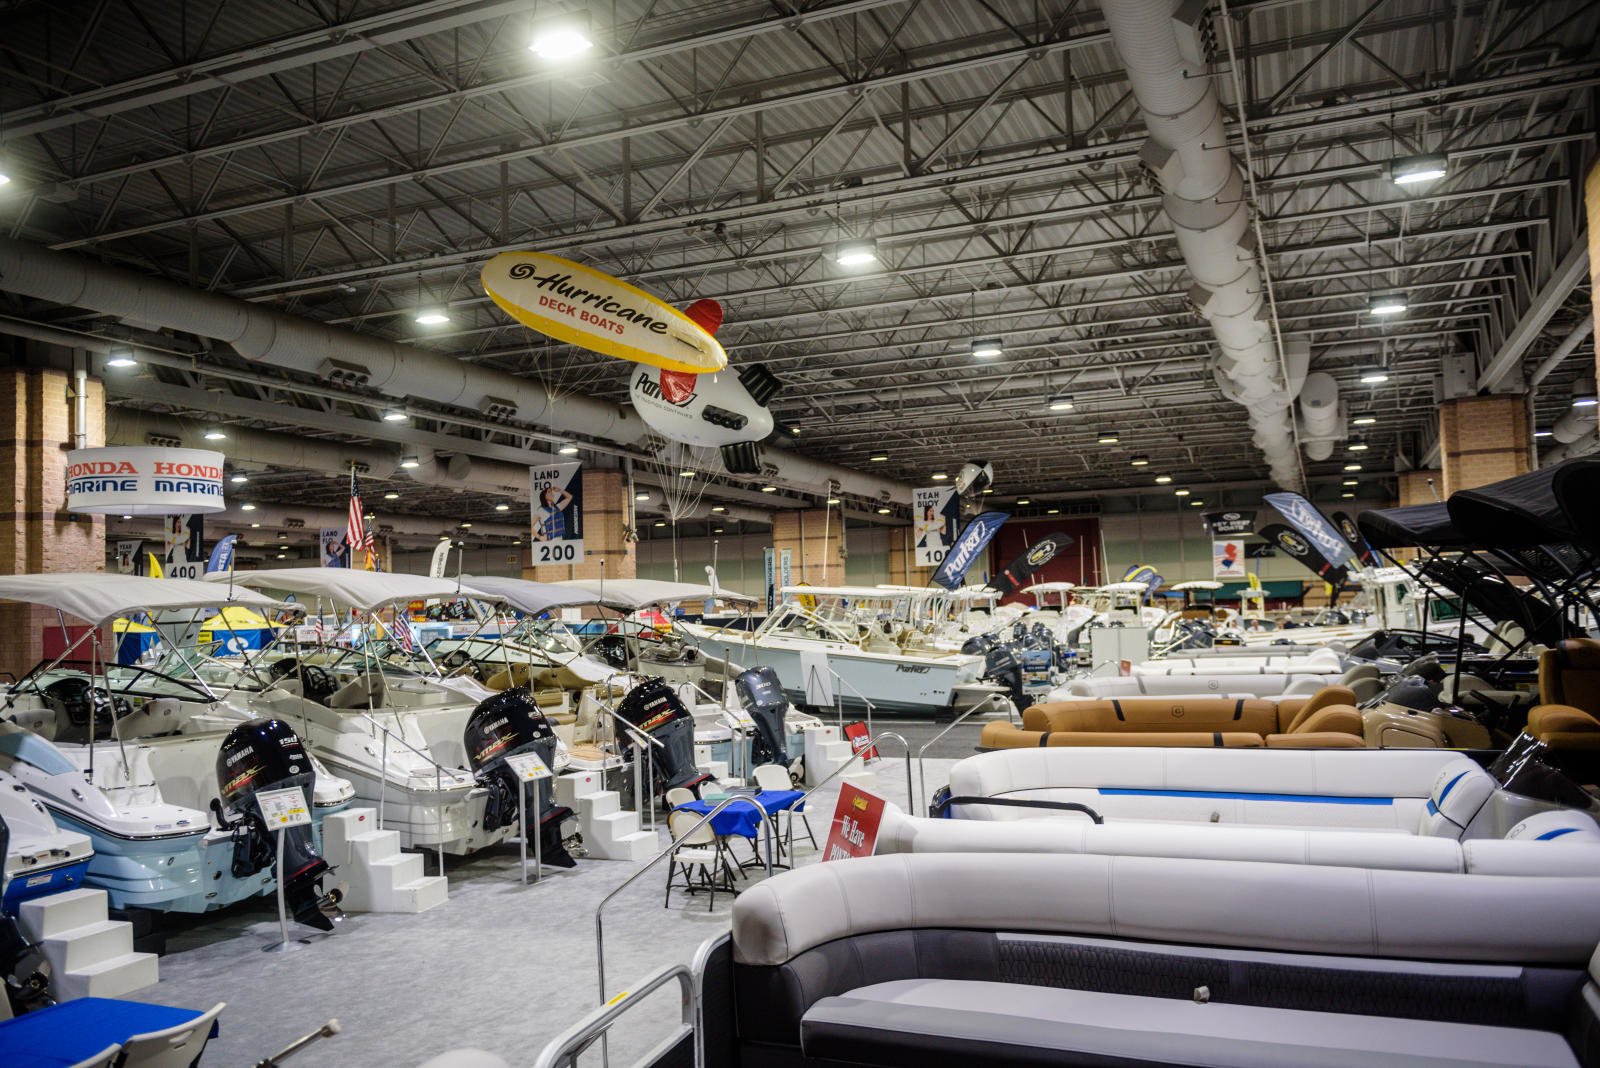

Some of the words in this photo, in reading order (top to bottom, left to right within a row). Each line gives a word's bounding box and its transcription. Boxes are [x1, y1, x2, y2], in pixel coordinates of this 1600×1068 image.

[533, 273, 669, 335] Hurricane
[538, 296, 577, 317] DECK
[579, 310, 625, 335] BOATS
[534, 470, 560, 480] LAND
[534, 481, 551, 491] FLO
[916, 491, 940, 500] YEAH
[917, 500, 939, 508] BUOY
[540, 544, 575, 562] 200
[170, 566, 196, 579] 400
[488, 716, 509, 732] YAMAHA
[230, 745, 254, 764] YAMAHA
[842, 815, 852, 839] We
[849, 819, 865, 848] Have
